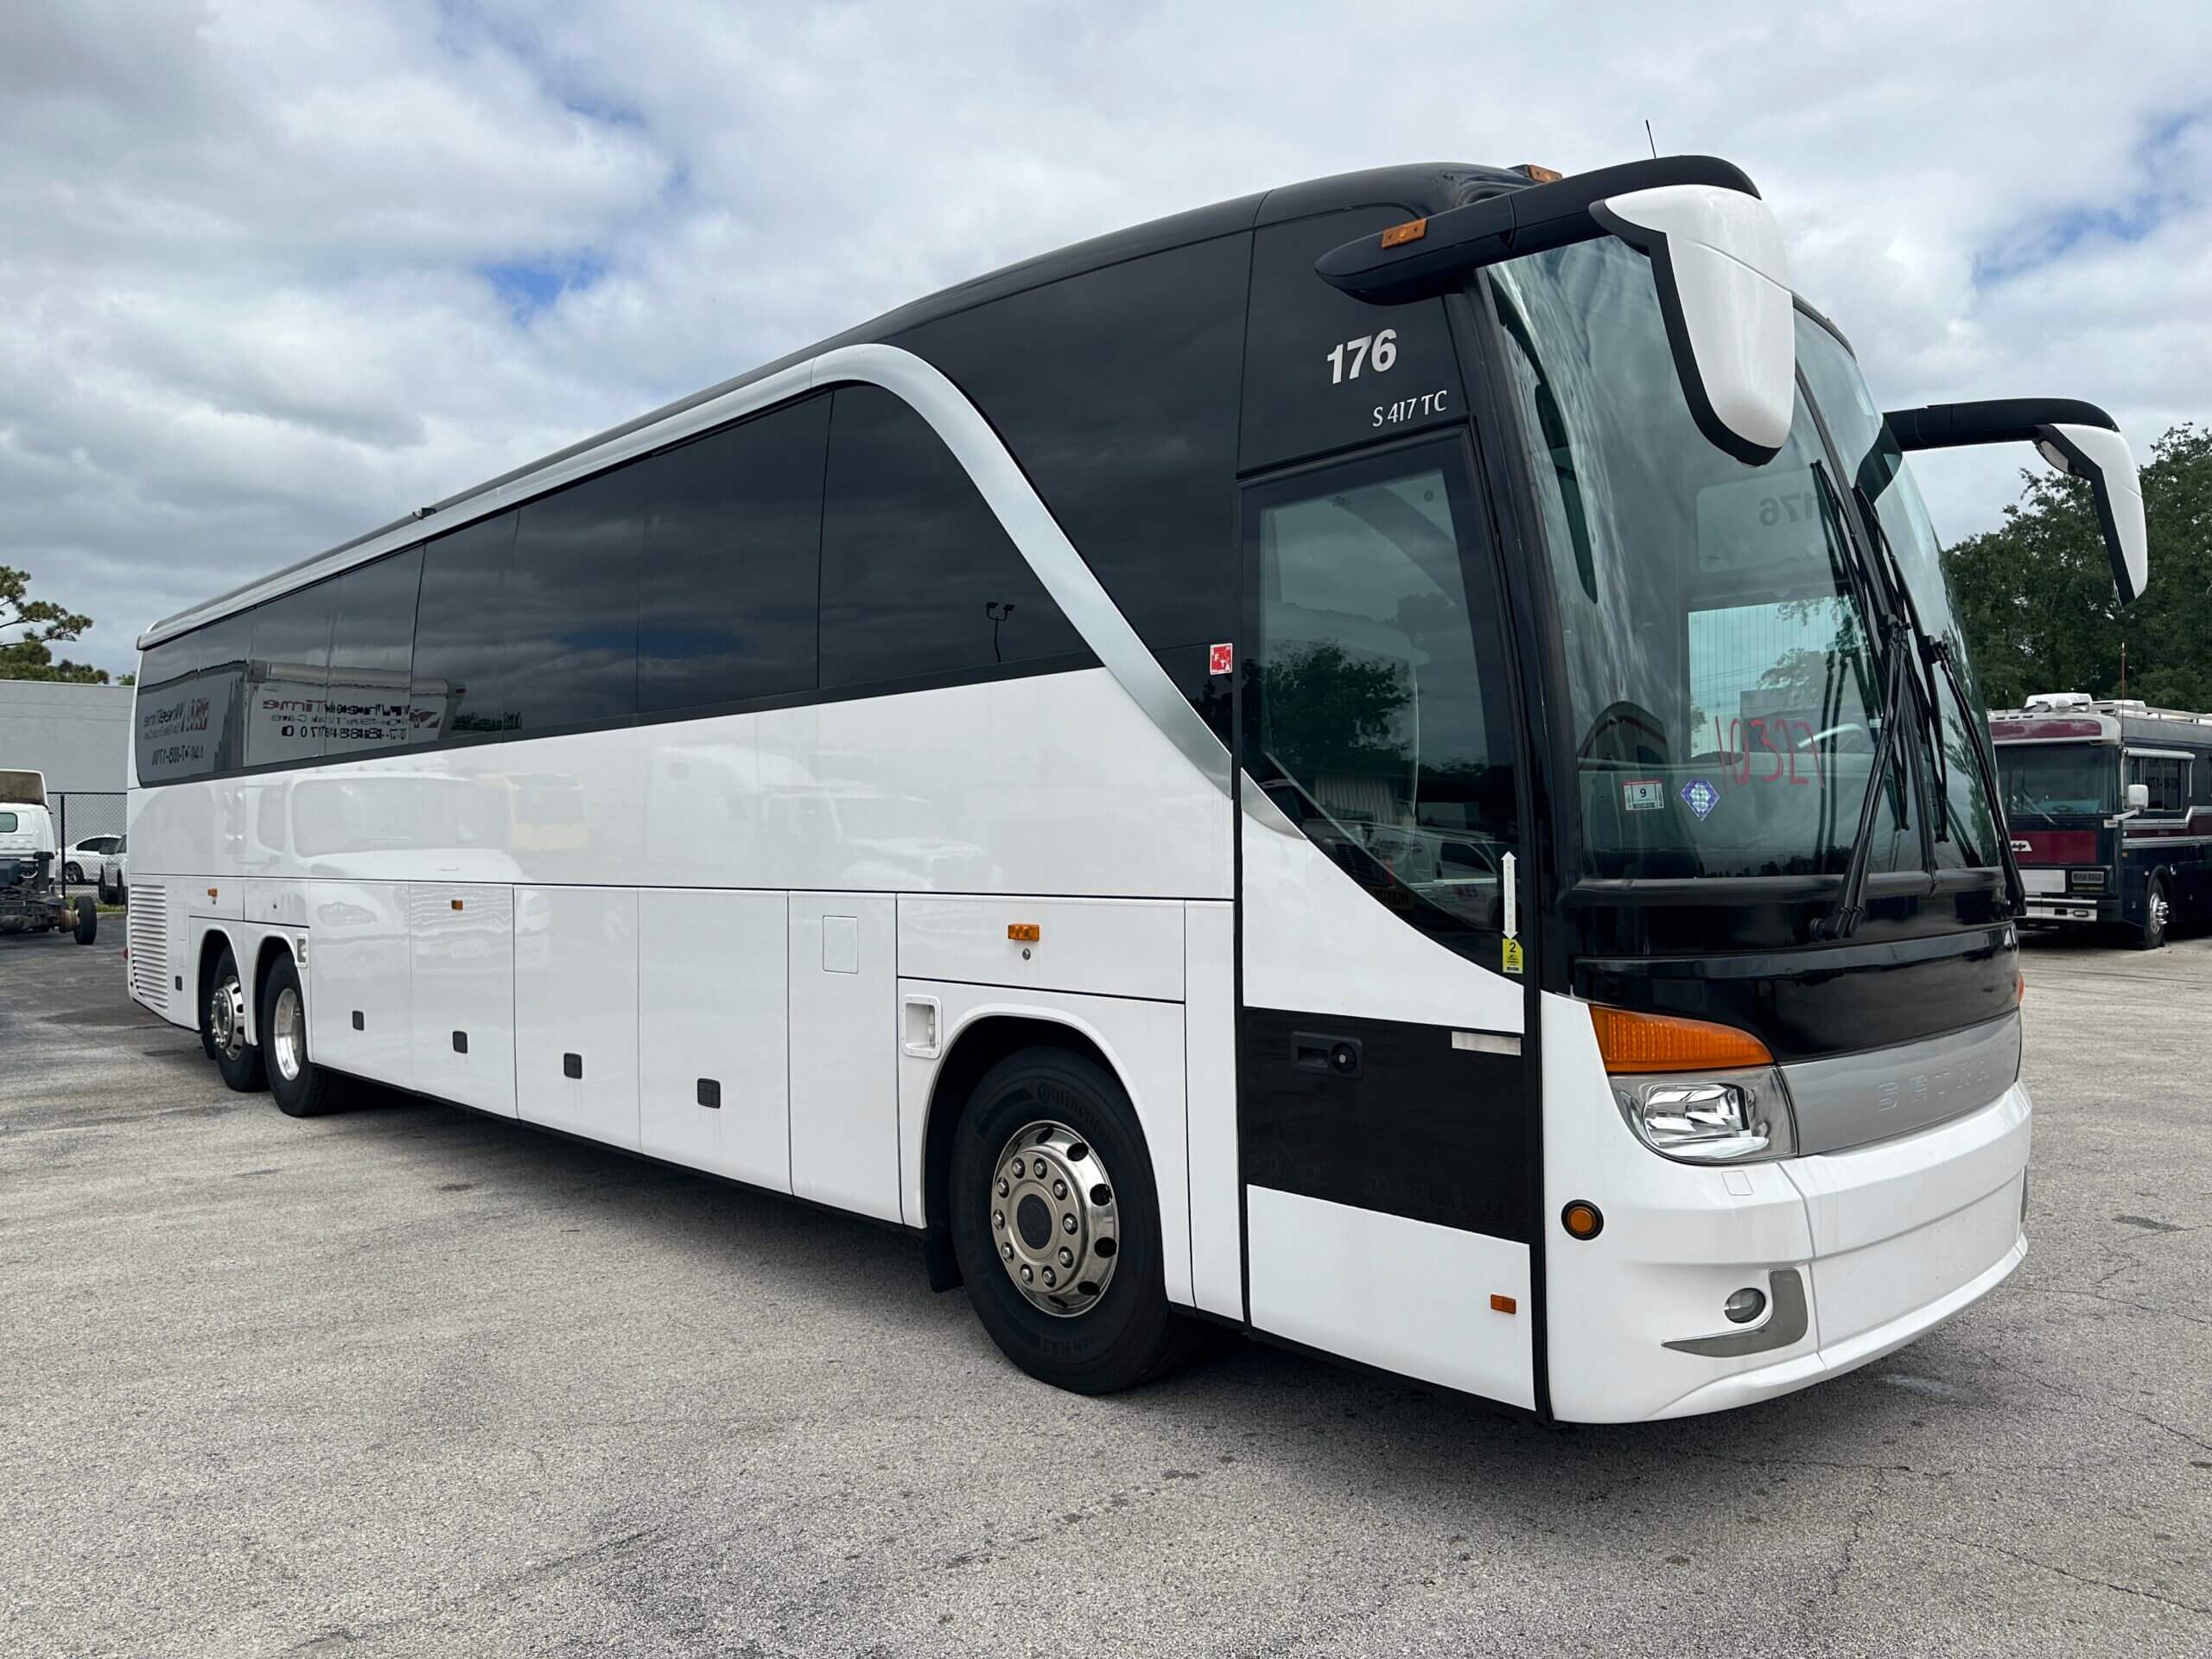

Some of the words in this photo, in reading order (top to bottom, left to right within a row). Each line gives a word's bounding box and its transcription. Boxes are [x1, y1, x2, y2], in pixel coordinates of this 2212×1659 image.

[1326, 328, 1397, 385] 176
[1372, 405, 1383, 428] S
[1388, 397, 1418, 423] 417
[1421, 389, 1448, 416] TC
[1639, 788, 1647, 798] 9
[1509, 942, 1516, 953] 2
